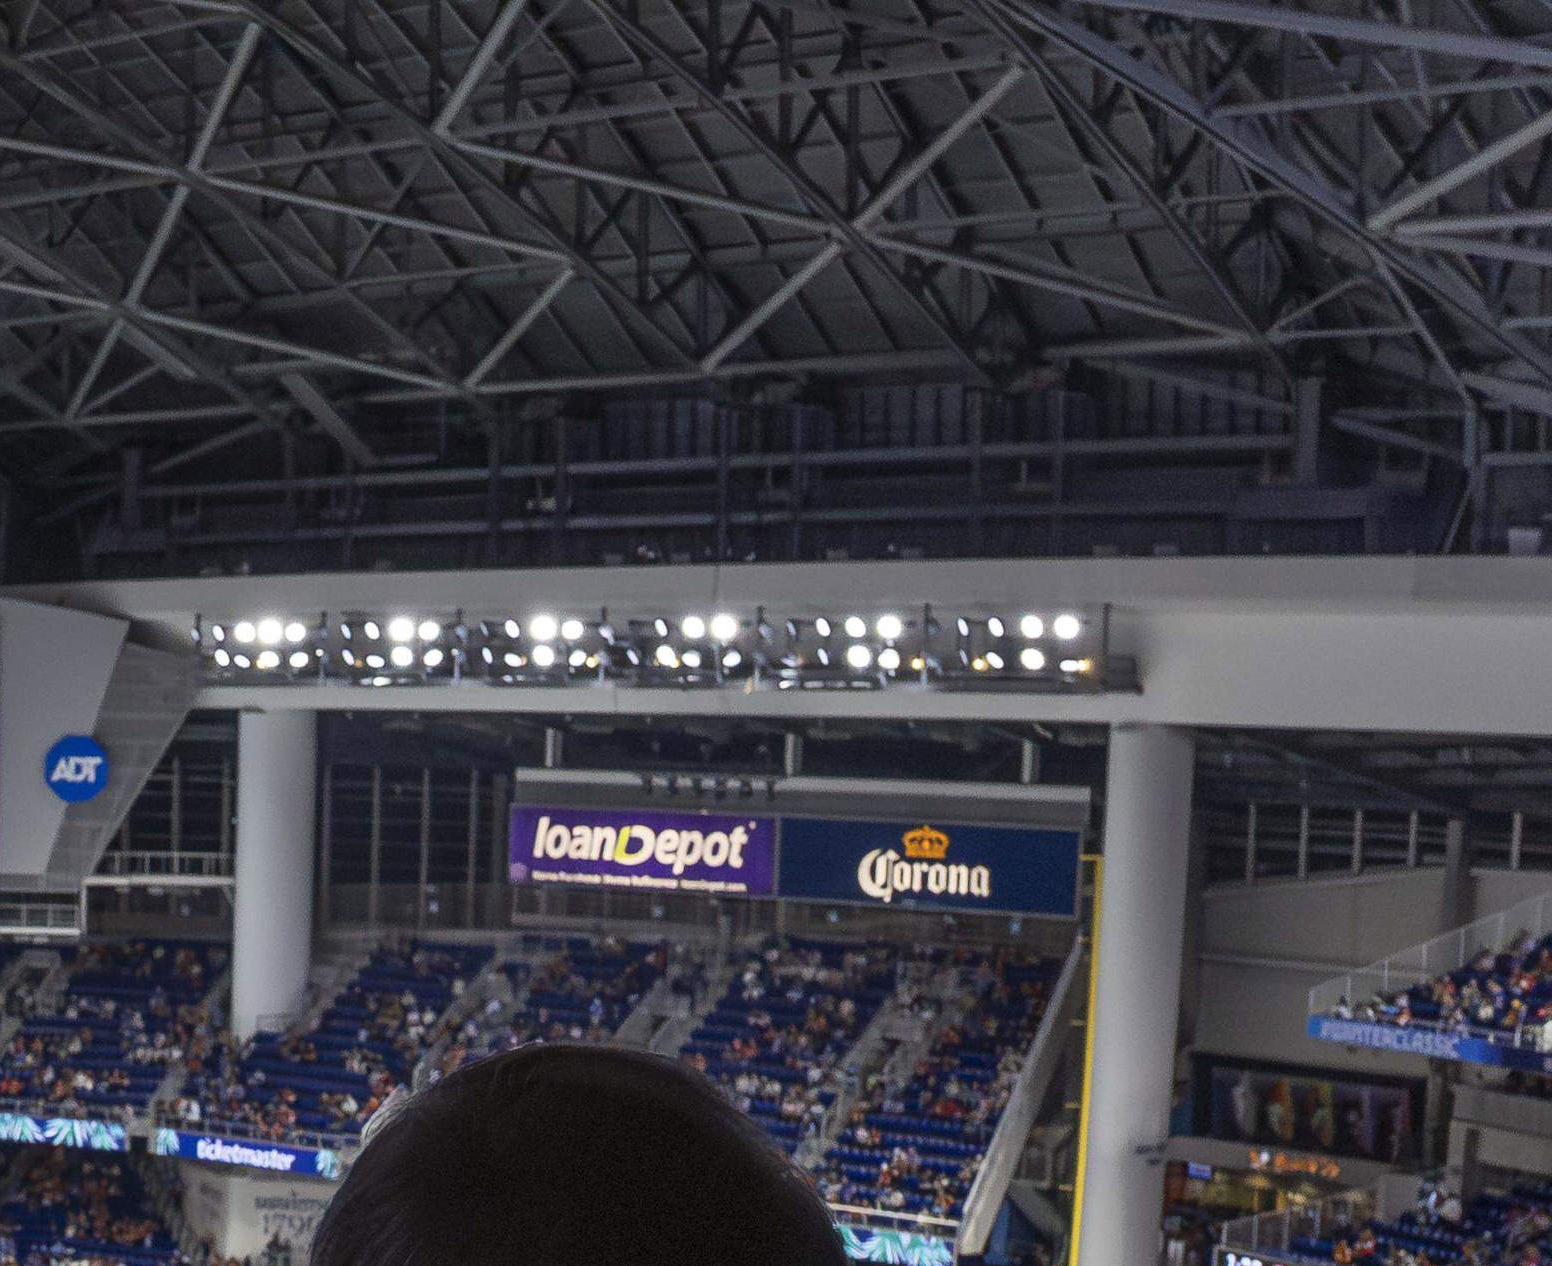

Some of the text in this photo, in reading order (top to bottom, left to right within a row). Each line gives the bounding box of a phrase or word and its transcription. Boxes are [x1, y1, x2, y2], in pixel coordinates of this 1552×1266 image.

[49, 755, 103, 784] ADT
[532, 815, 749, 875] loanDepot
[857, 847, 991, 903] Corona
